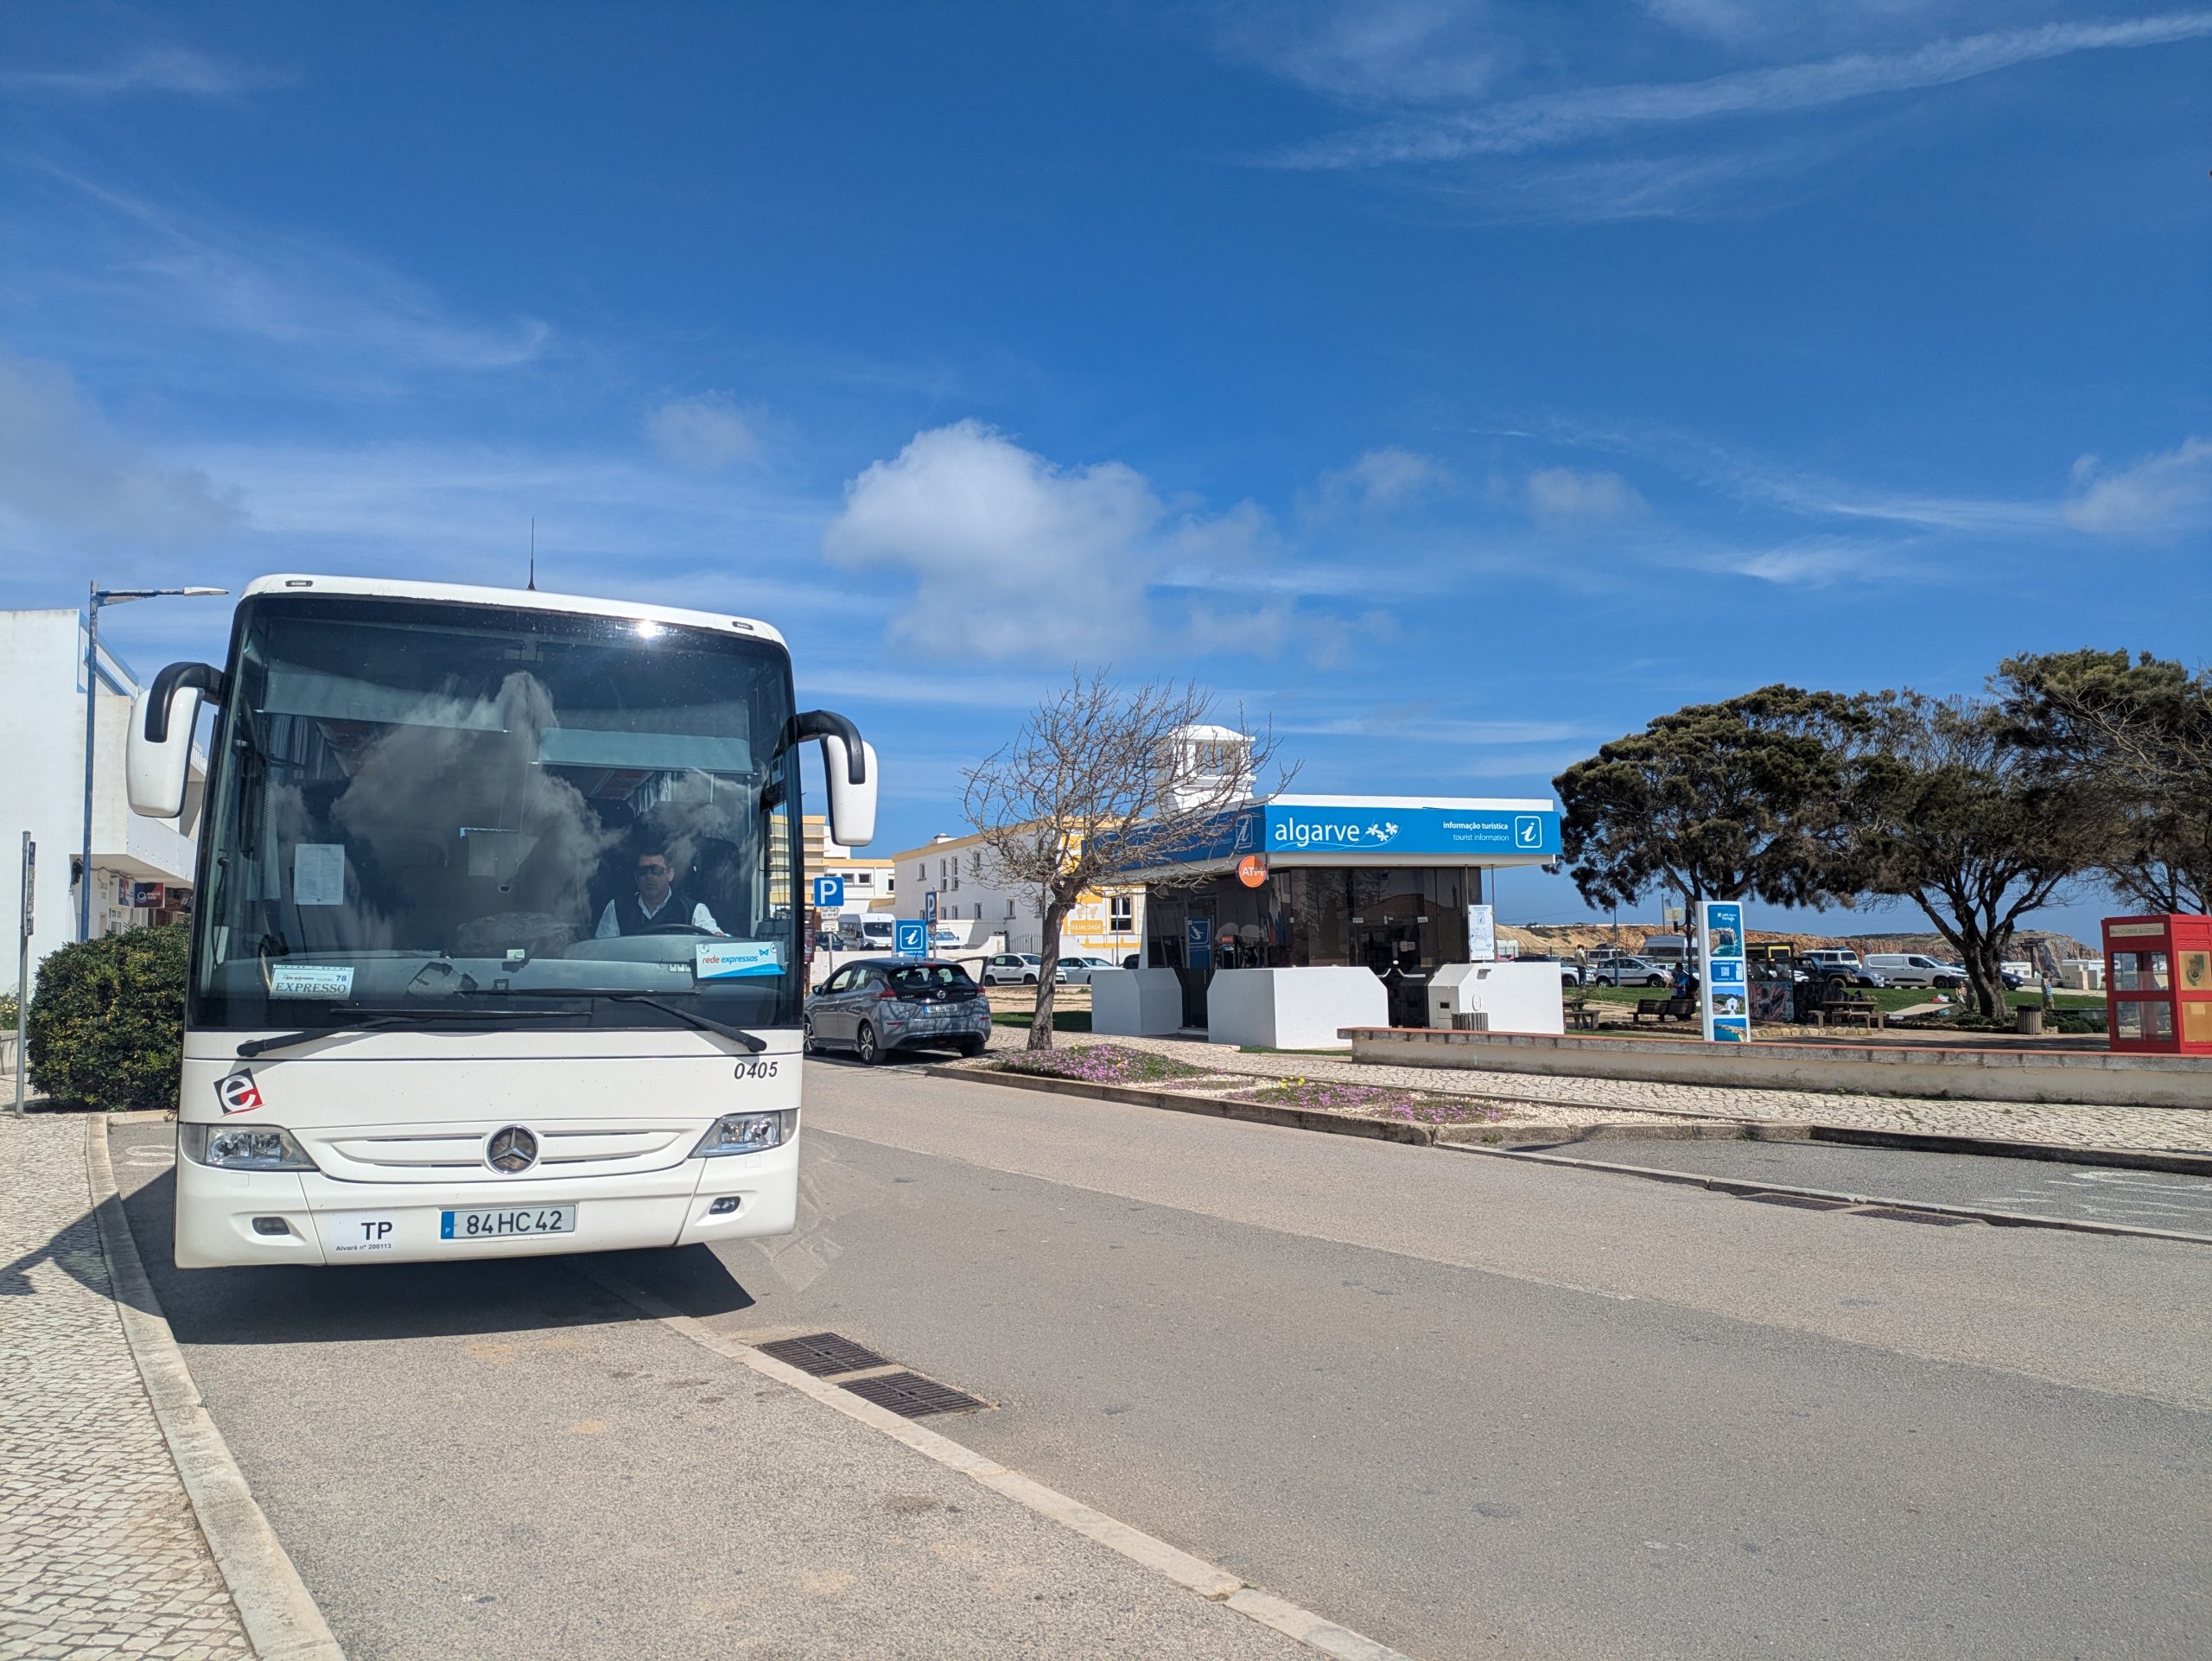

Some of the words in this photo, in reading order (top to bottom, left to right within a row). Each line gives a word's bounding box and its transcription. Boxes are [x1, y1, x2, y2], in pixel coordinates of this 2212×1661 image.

[1274, 817, 1360, 848] algarve
[1442, 821, 1481, 830] informação
[1474, 833, 1510, 842] information
[1242, 866, 1264, 876] ATM
[820, 880, 837, 905] P
[927, 894, 935, 922] P
[702, 955, 720, 964] rede
[276, 982, 346, 993] EXPRESSO
[734, 1061, 778, 1079] 0405
[360, 1221, 393, 1240] TP
